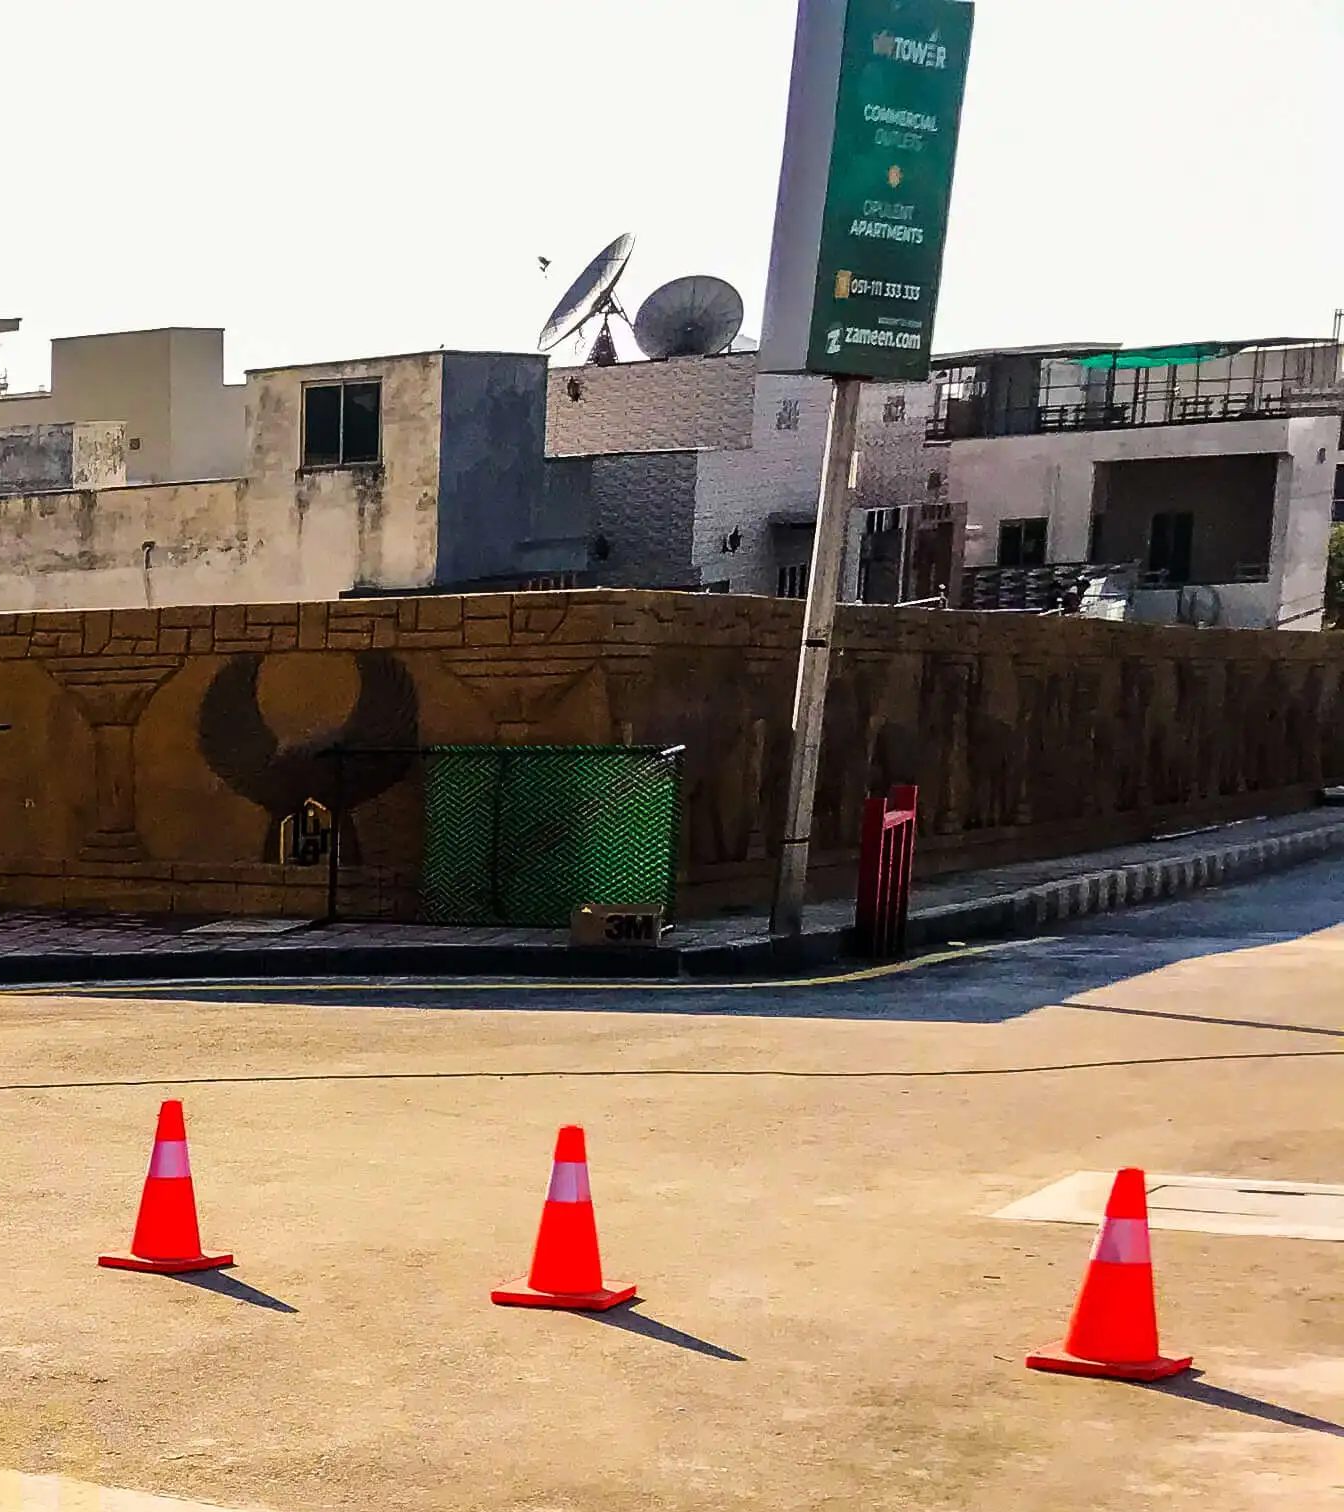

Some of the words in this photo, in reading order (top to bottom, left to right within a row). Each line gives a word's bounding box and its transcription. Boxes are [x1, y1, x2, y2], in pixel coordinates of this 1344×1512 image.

[894, 29, 946, 69] TOWER
[863, 103, 938, 132] COMMERCIAL
[849, 219, 924, 244] APARTMENTS
[844, 326, 921, 350] zameen.com
[604, 913, 653, 941] 3M
